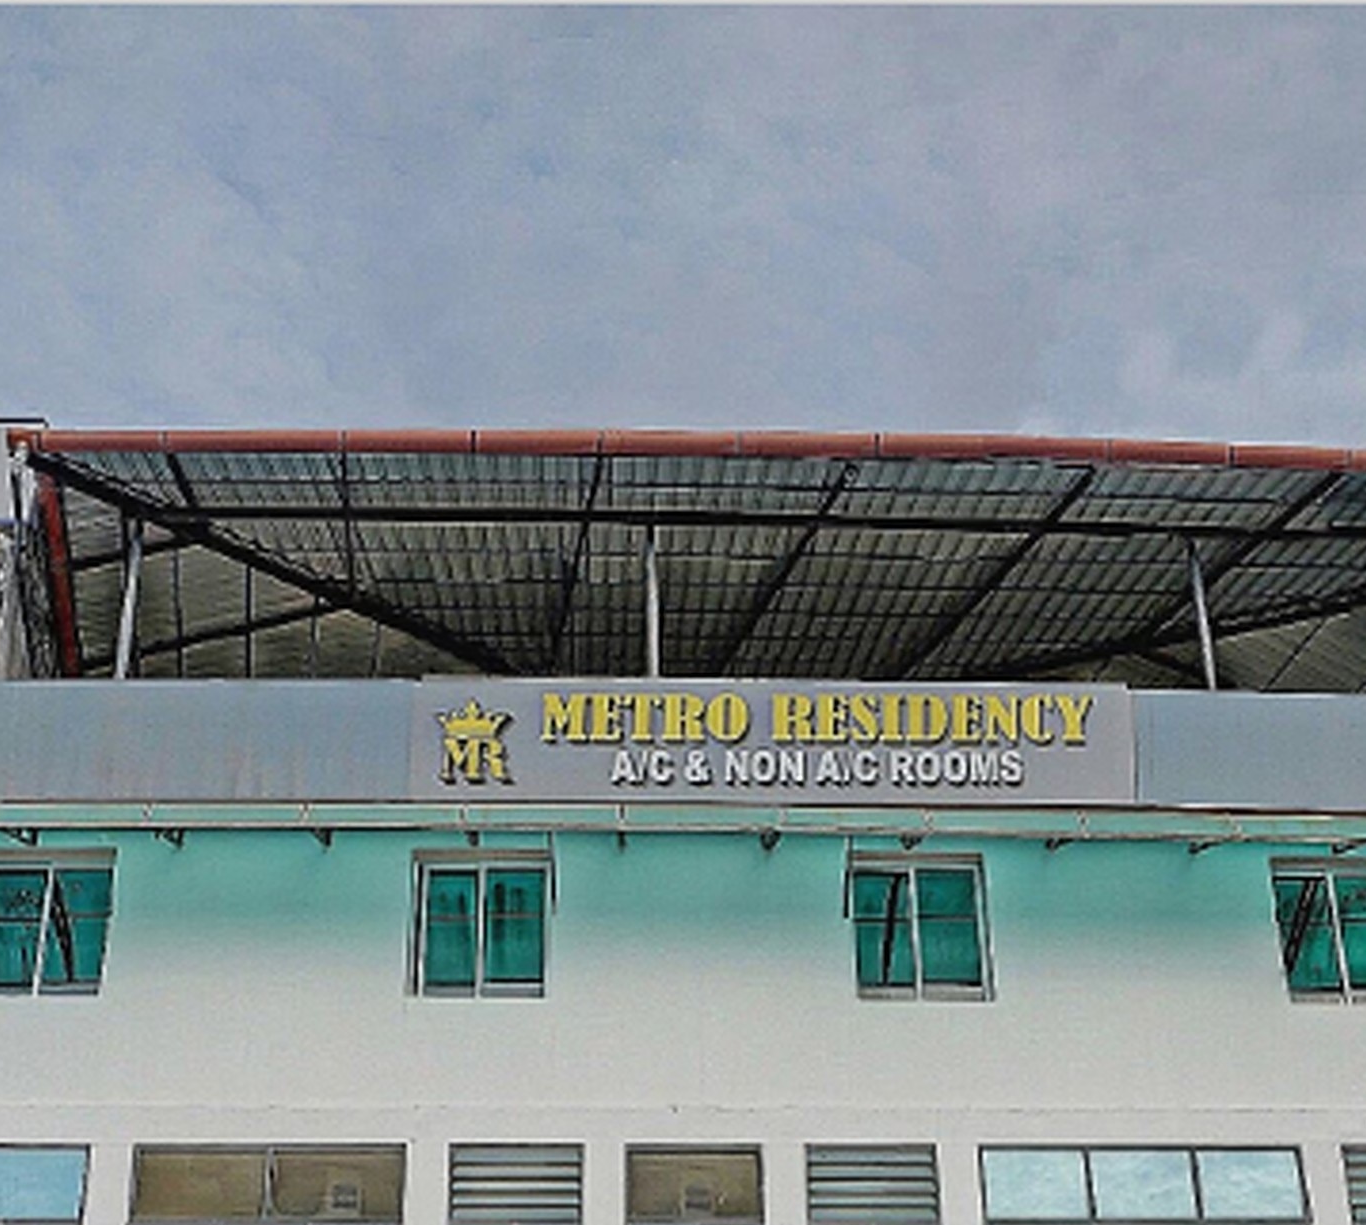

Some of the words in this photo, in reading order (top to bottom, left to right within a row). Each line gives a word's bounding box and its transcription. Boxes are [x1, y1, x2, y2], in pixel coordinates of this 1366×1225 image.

[540, 692, 750, 744] METRO
[769, 692, 1096, 745] RESIDENCY
[683, 749, 714, 787] &
[724, 749, 806, 788] NON
[889, 749, 1025, 788] ROOMS
